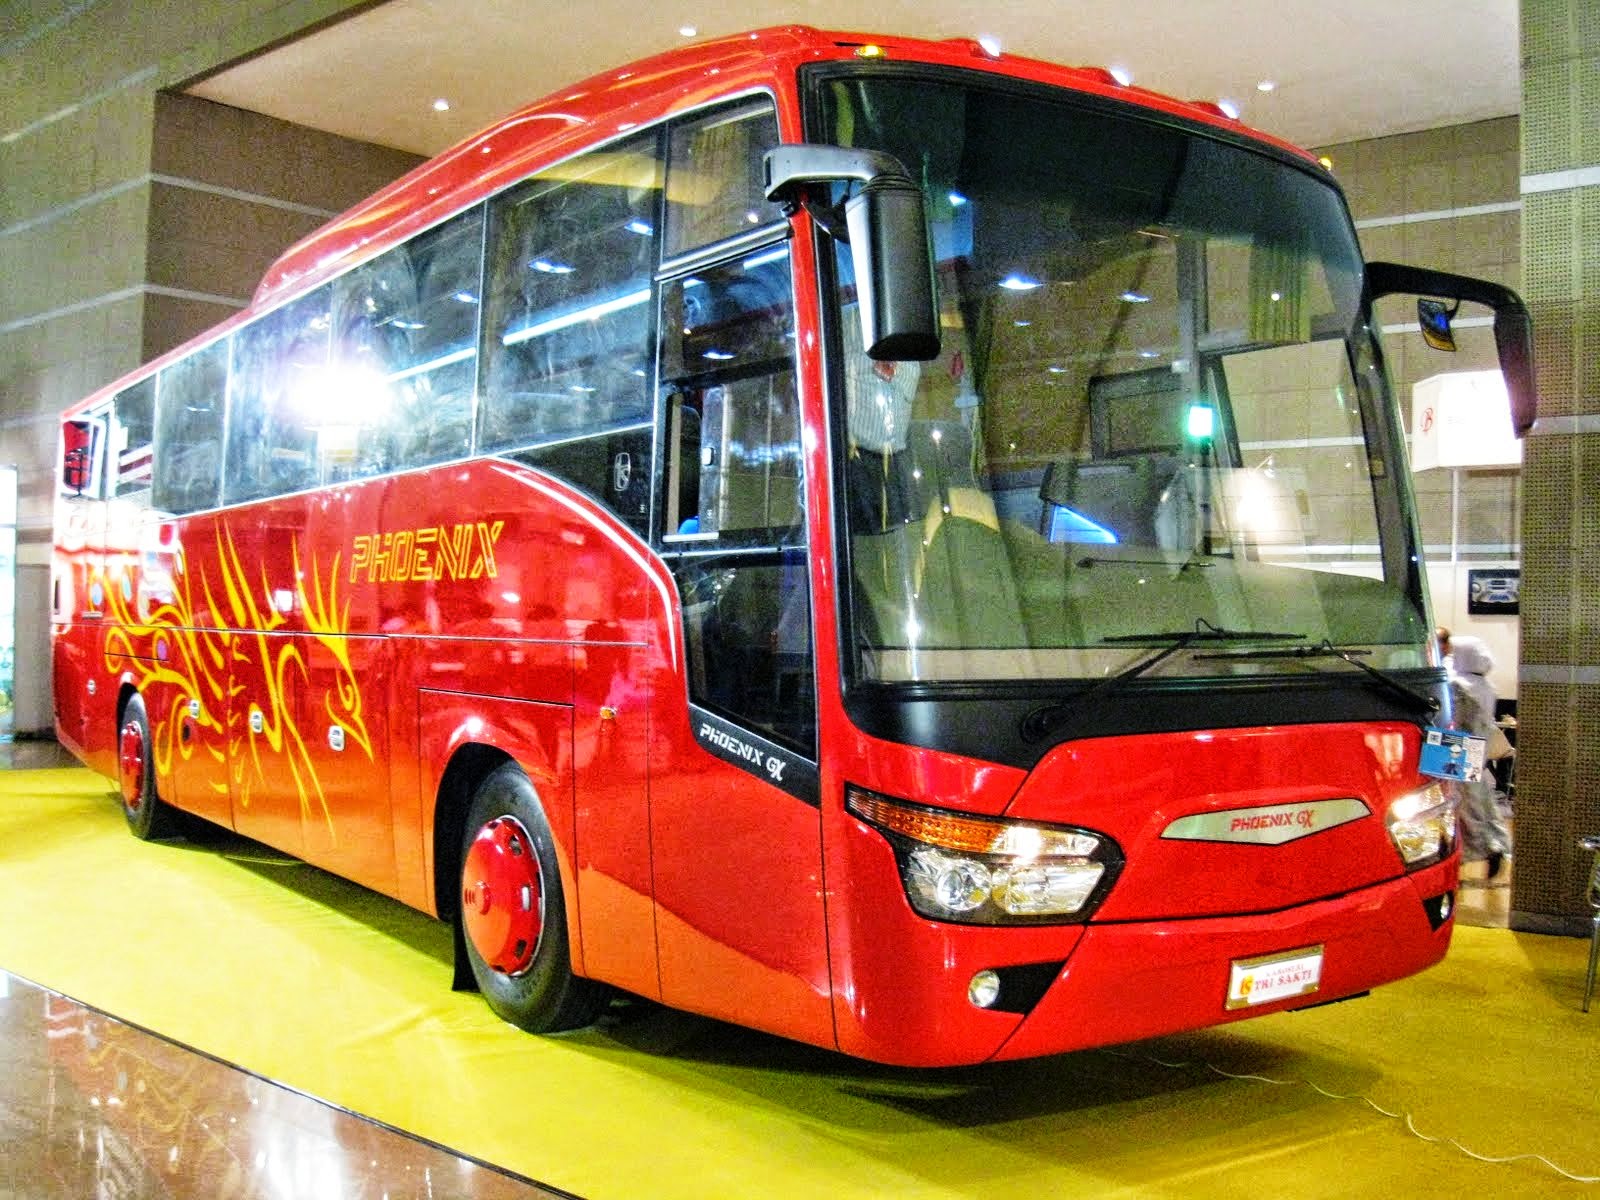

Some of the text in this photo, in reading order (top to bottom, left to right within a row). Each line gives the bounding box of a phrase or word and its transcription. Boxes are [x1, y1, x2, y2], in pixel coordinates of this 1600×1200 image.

[349, 520, 505, 583] PHOENIX
[699, 723, 786, 781] PHOENIX GX
[1230, 809, 1315, 832] PHOENIX GX
